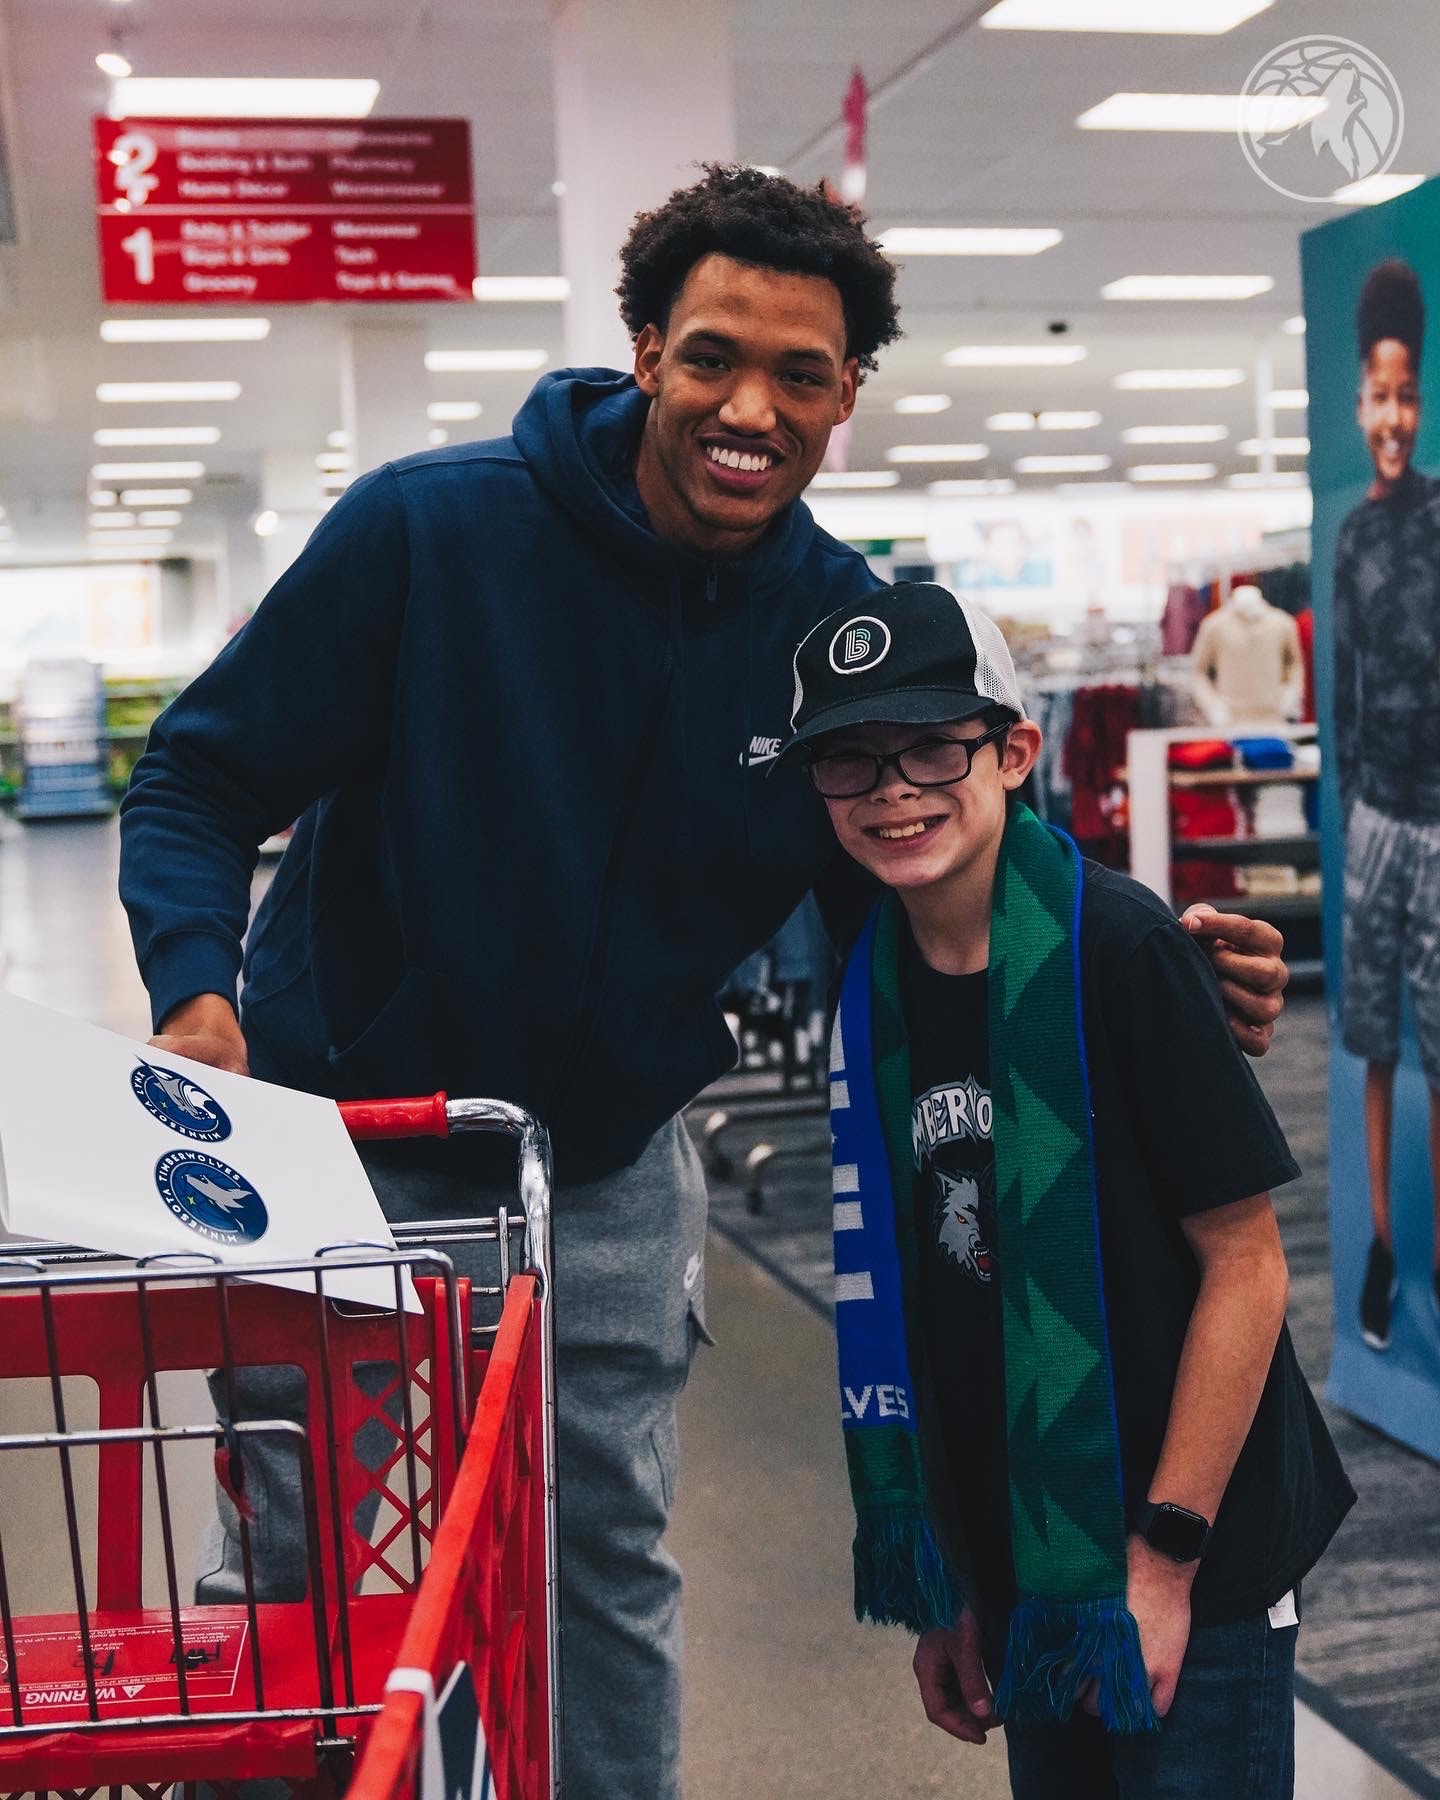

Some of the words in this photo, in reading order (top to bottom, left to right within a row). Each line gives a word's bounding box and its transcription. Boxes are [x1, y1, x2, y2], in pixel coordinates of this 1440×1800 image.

[121, 228, 155, 284] 1
[749, 735, 782, 756] NIKE
[133, 1071, 145, 1096] LYNX
[144, 1101, 222, 1140] MINNESOTA
[158, 1152, 241, 1182] TIMBERWOLVES
[160, 1189, 239, 1243] MINNESOTA
[25, 1687, 116, 1705] WRNING
